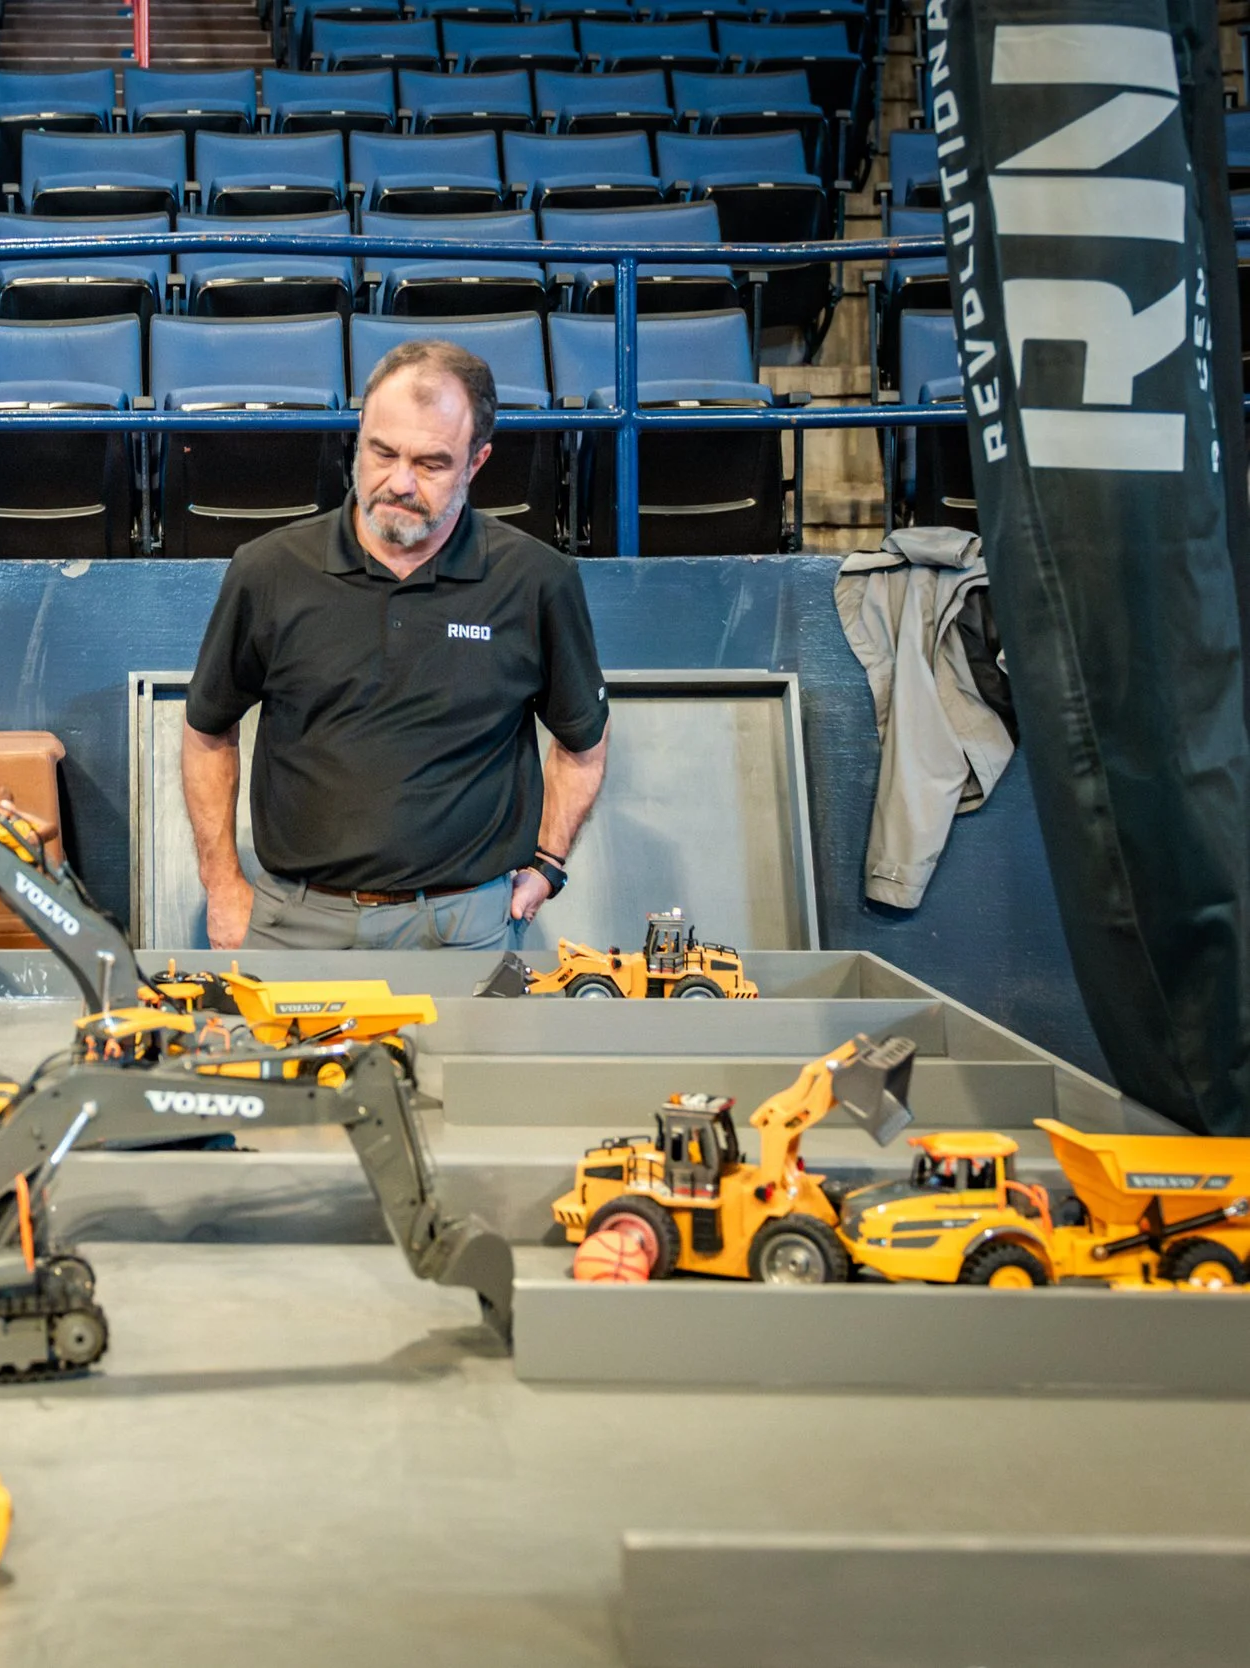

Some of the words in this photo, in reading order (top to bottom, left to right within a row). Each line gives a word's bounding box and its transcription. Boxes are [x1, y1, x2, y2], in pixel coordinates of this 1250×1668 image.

[14, 871, 80, 936] VOLVO
[278, 1003, 322, 1013] VOLVO
[144, 1089, 265, 1119] VOLVO
